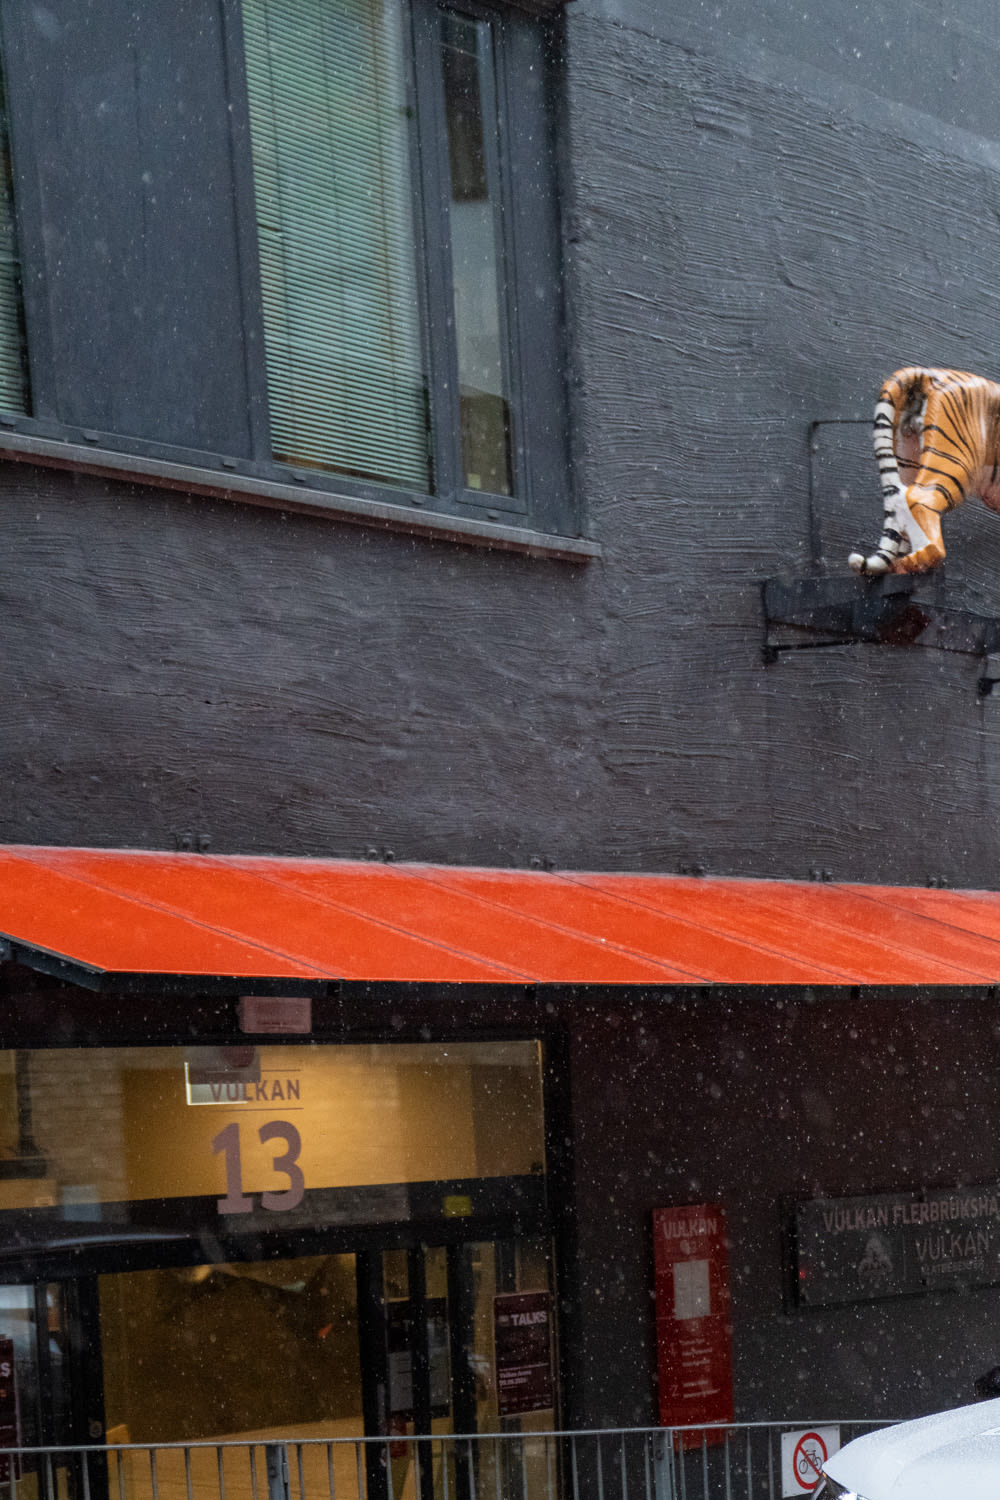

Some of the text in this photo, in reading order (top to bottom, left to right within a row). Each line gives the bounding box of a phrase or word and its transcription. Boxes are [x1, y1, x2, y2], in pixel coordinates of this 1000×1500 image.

[209, 1079, 301, 1102] VULKAN
[211, 1120, 306, 1214] 13
[663, 1218, 718, 1240] VULKAN
[823, 1207, 889, 1233] VULKAN
[915, 1231, 990, 1262] VULKAN
[510, 1310, 548, 1327] TALKS
